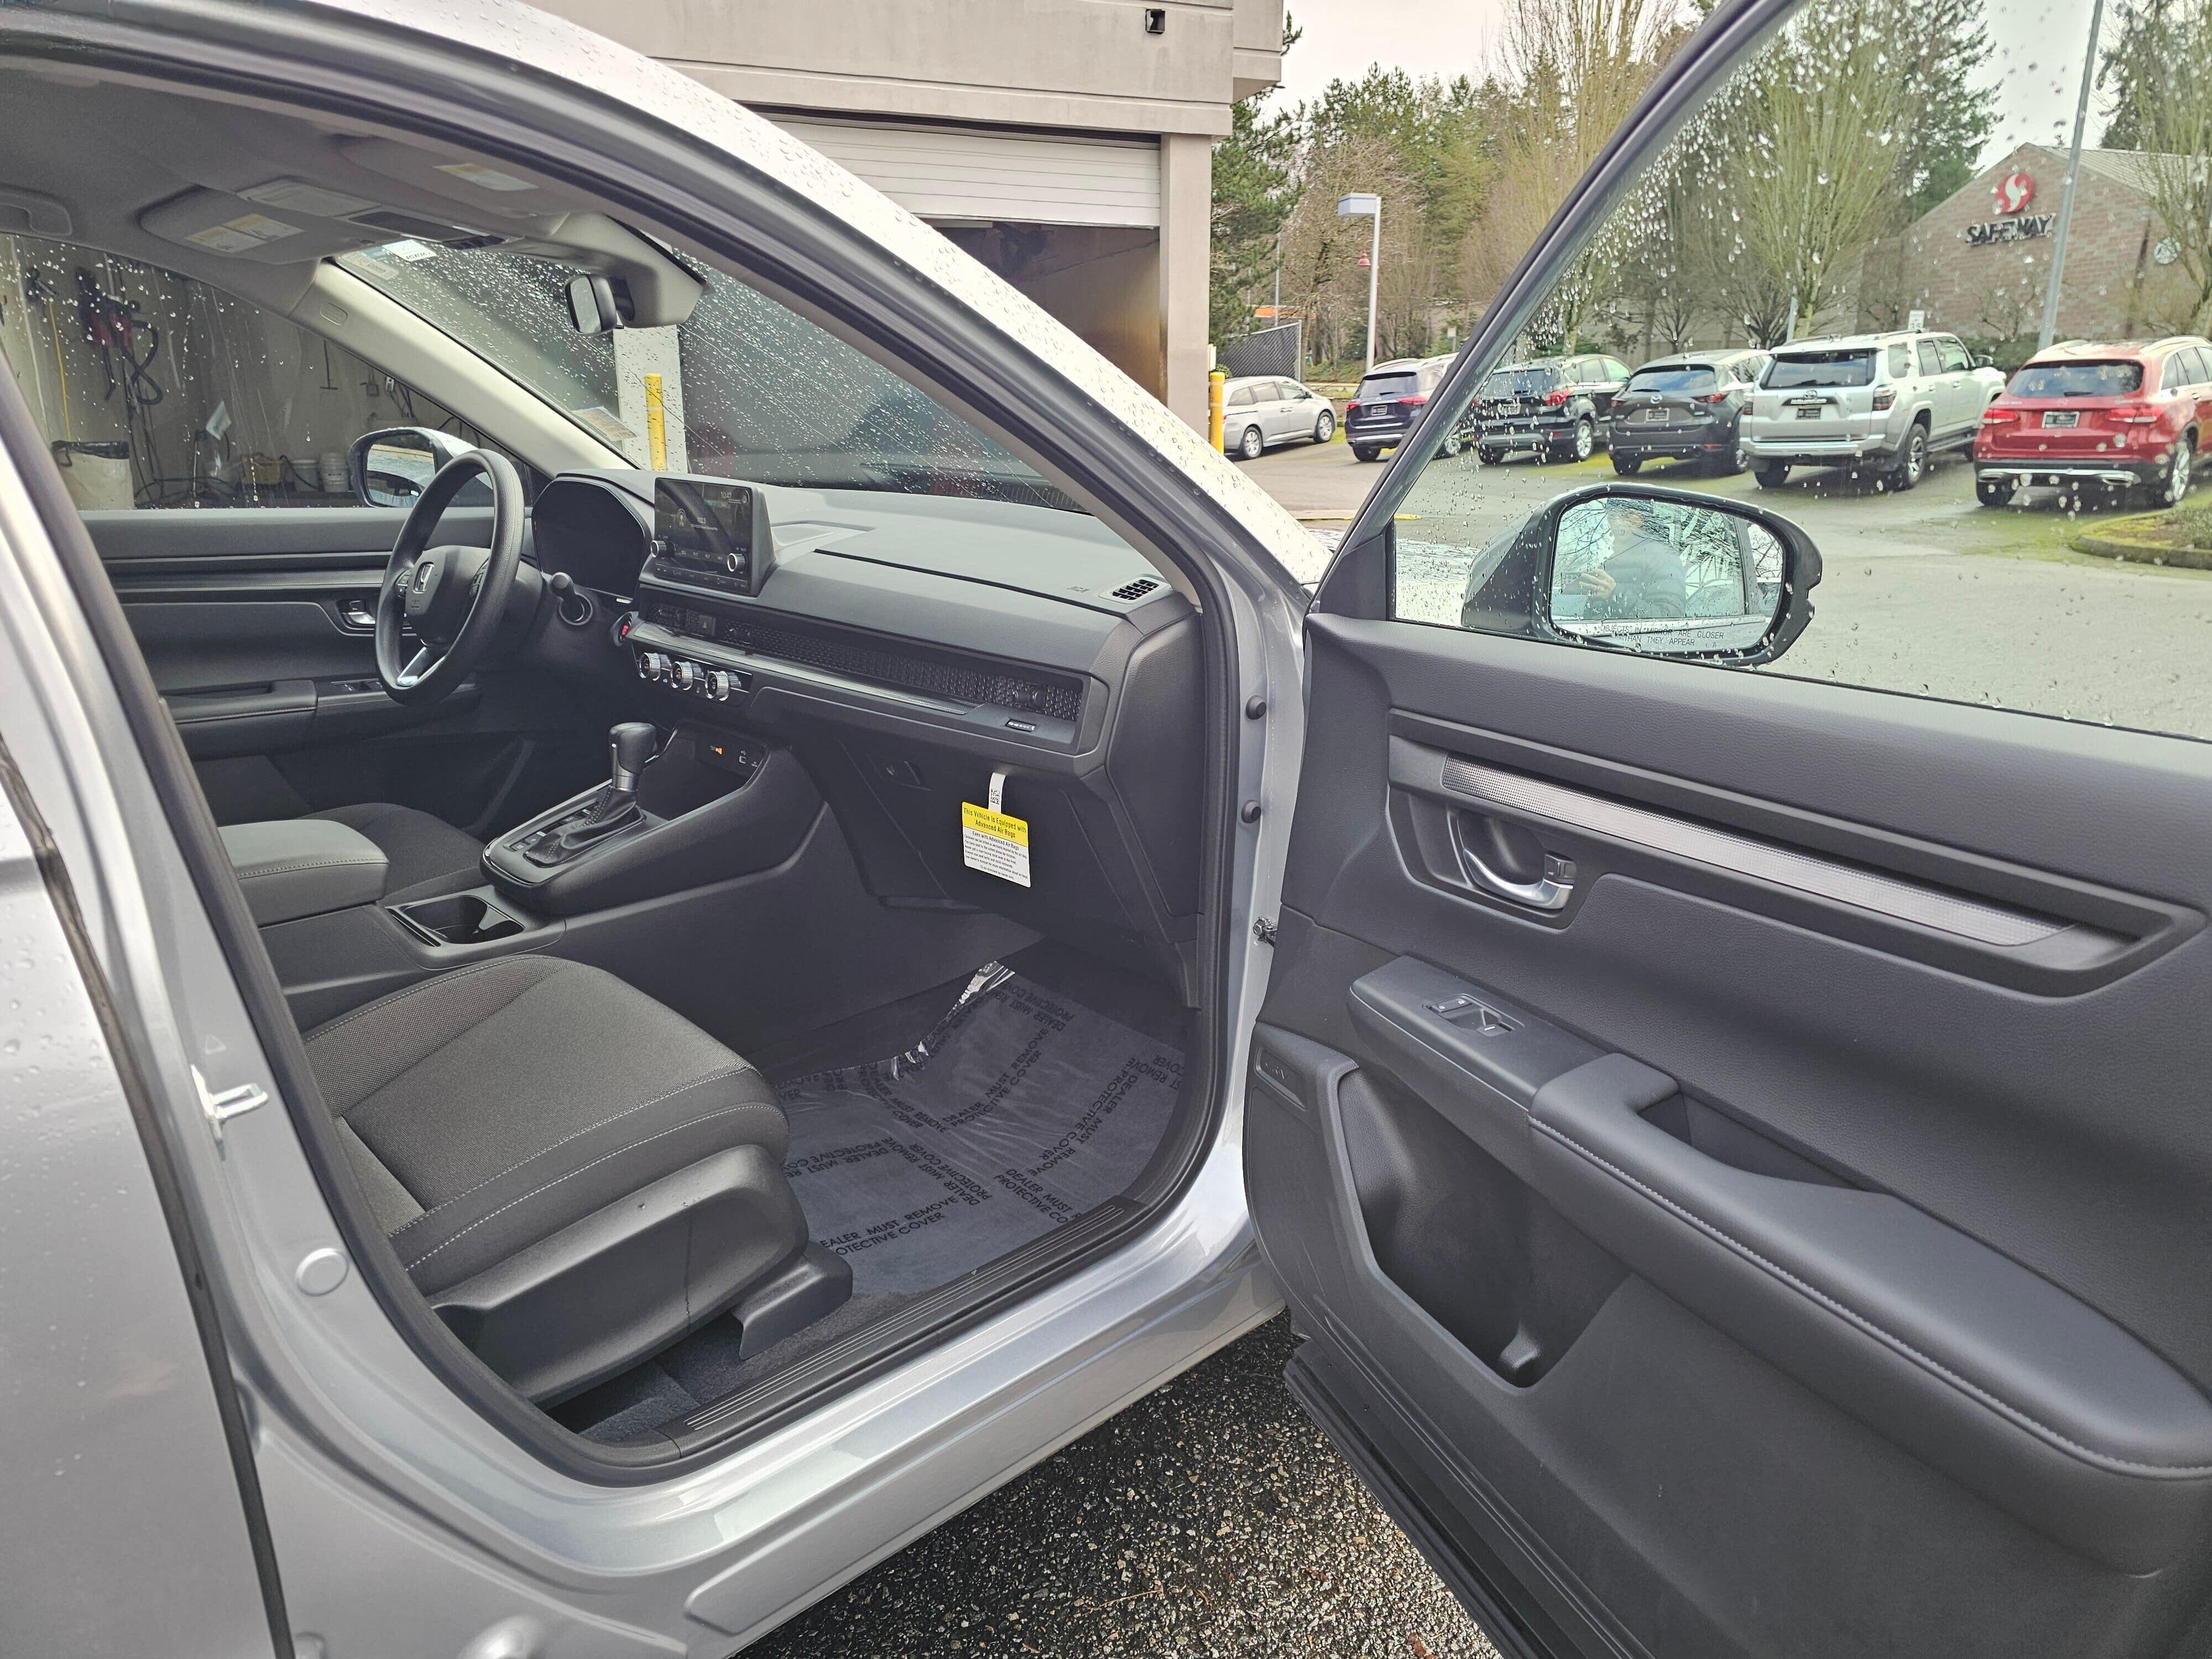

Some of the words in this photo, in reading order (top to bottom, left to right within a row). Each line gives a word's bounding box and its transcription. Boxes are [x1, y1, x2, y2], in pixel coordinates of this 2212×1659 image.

[1600, 624, 1630, 634] OBJECTS
[1646, 627, 1673, 637] MIRROR
[1678, 629, 1691, 638] ARE
[1697, 630, 1724, 639] CLOSER
[1624, 634, 1641, 643] THAN
[1647, 636, 1663, 644] THEY
[1669, 637, 1695, 646] APPEAR
[964, 807, 973, 816] This
[974, 810, 989, 821] Vehicle
[996, 817, 1016, 830] Equipped
[975, 819, 997, 832] Advanced
[1004, 829, 1015, 838] Bags
[942, 1102, 984, 1123] DEALER
[984, 1072, 1010, 1098] MUST
[1011, 1028, 1048, 1070] REMOVE
[1125, 1057, 1168, 1083] REMOVE
[951, 1087, 1011, 1127] PROTECTIVE
[1010, 1050, 1042, 1086] COVER
[1075, 1068, 1129, 1131] PROTECTIVE
[1103, 1074, 1138, 1114] DEALER
[1076, 1117, 1103, 1145] MUST
[881, 1136, 920, 1164] REMOVE
[909, 1142, 941, 1165] COVER
[1039, 1131, 1078, 1160] COVER
[807, 1159, 839, 1173] MUST
[917, 1163, 946, 1181] MUST
[1027, 1147, 1076, 1176] REMOVE
[938, 1164, 993, 1200] PROTECTIVE
[943, 1180, 980, 1206] DEALER
[993, 1174, 1052, 1213] PROTECTIVE
[1005, 1168, 1044, 1193] DEALER
[1043, 1193, 1073, 1213] MUST
[820, 1232, 862, 1248] EALER
[866, 1219, 901, 1236] MUST
[904, 1195, 959, 1220] REMOVE
[835, 1229, 899, 1255] OTECTIVE
[899, 1212, 944, 1235] COVER
